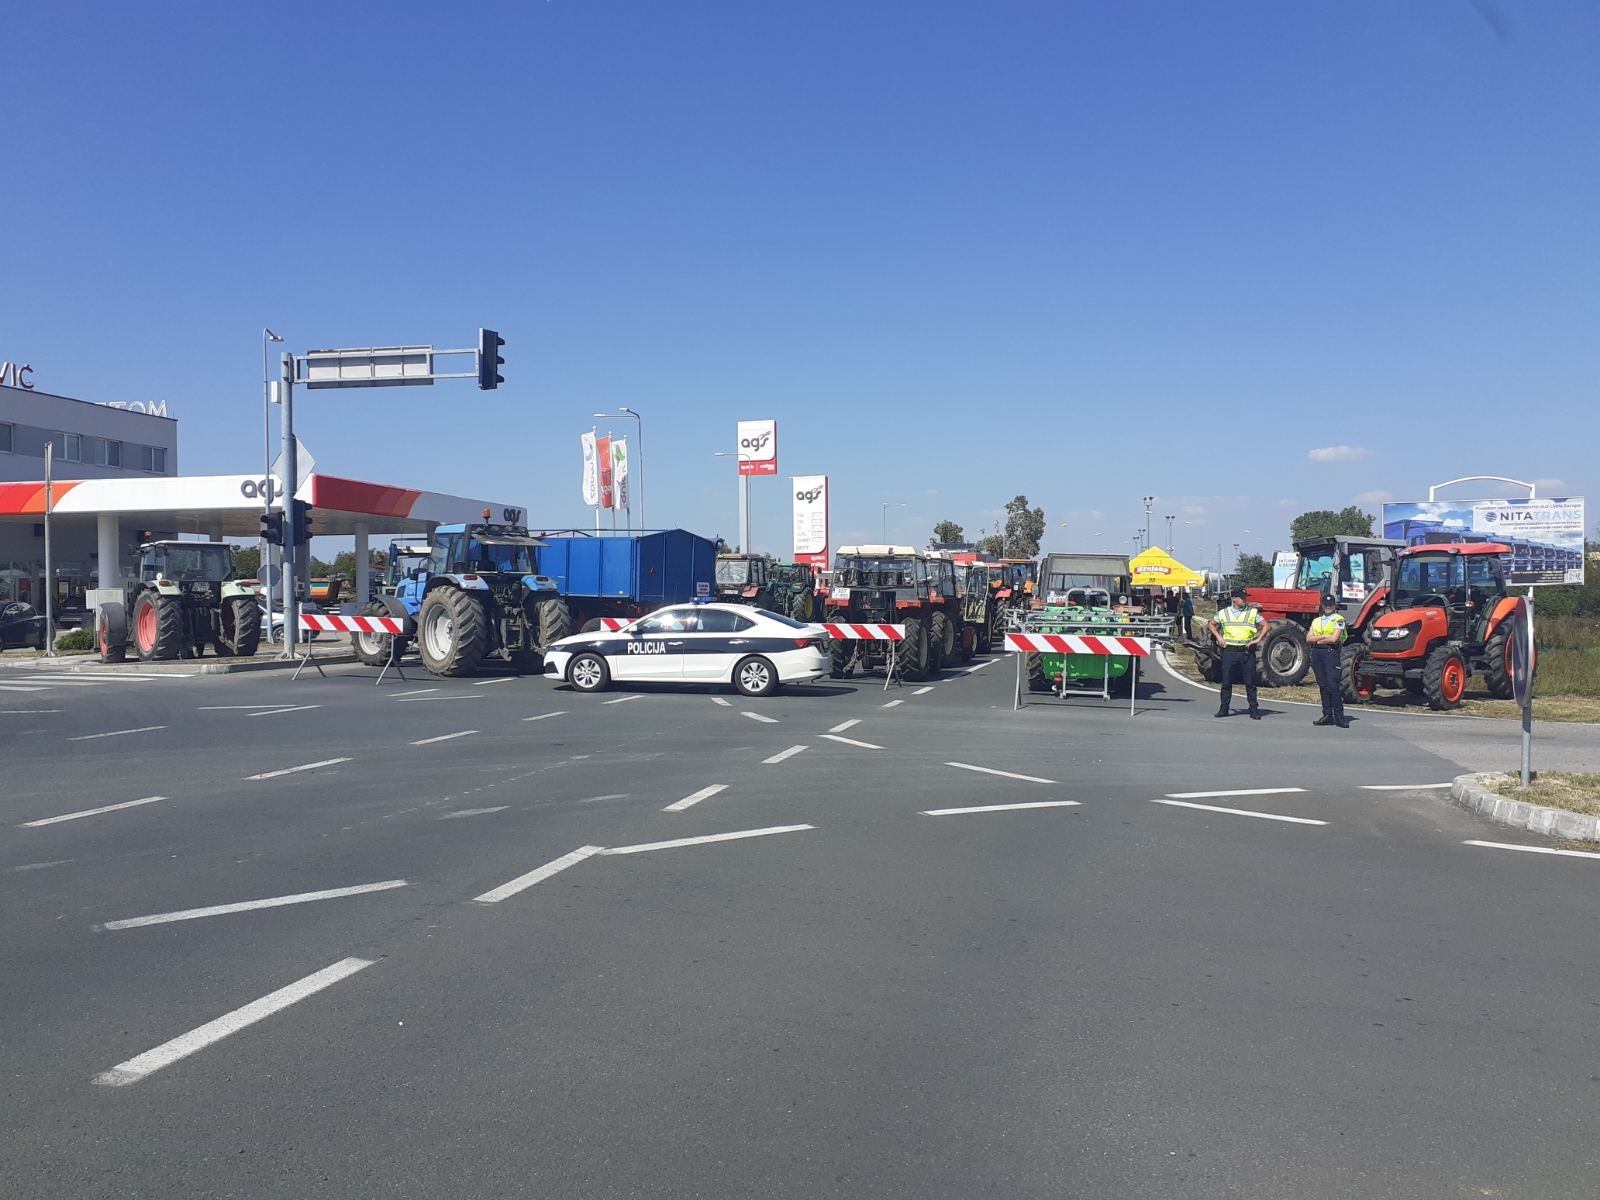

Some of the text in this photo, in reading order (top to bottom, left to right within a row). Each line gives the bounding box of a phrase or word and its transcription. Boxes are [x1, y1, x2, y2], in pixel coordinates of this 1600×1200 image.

[741, 437, 769, 452] ags
[796, 490, 822, 504] ags
[627, 641, 667, 655] POLICIJA
